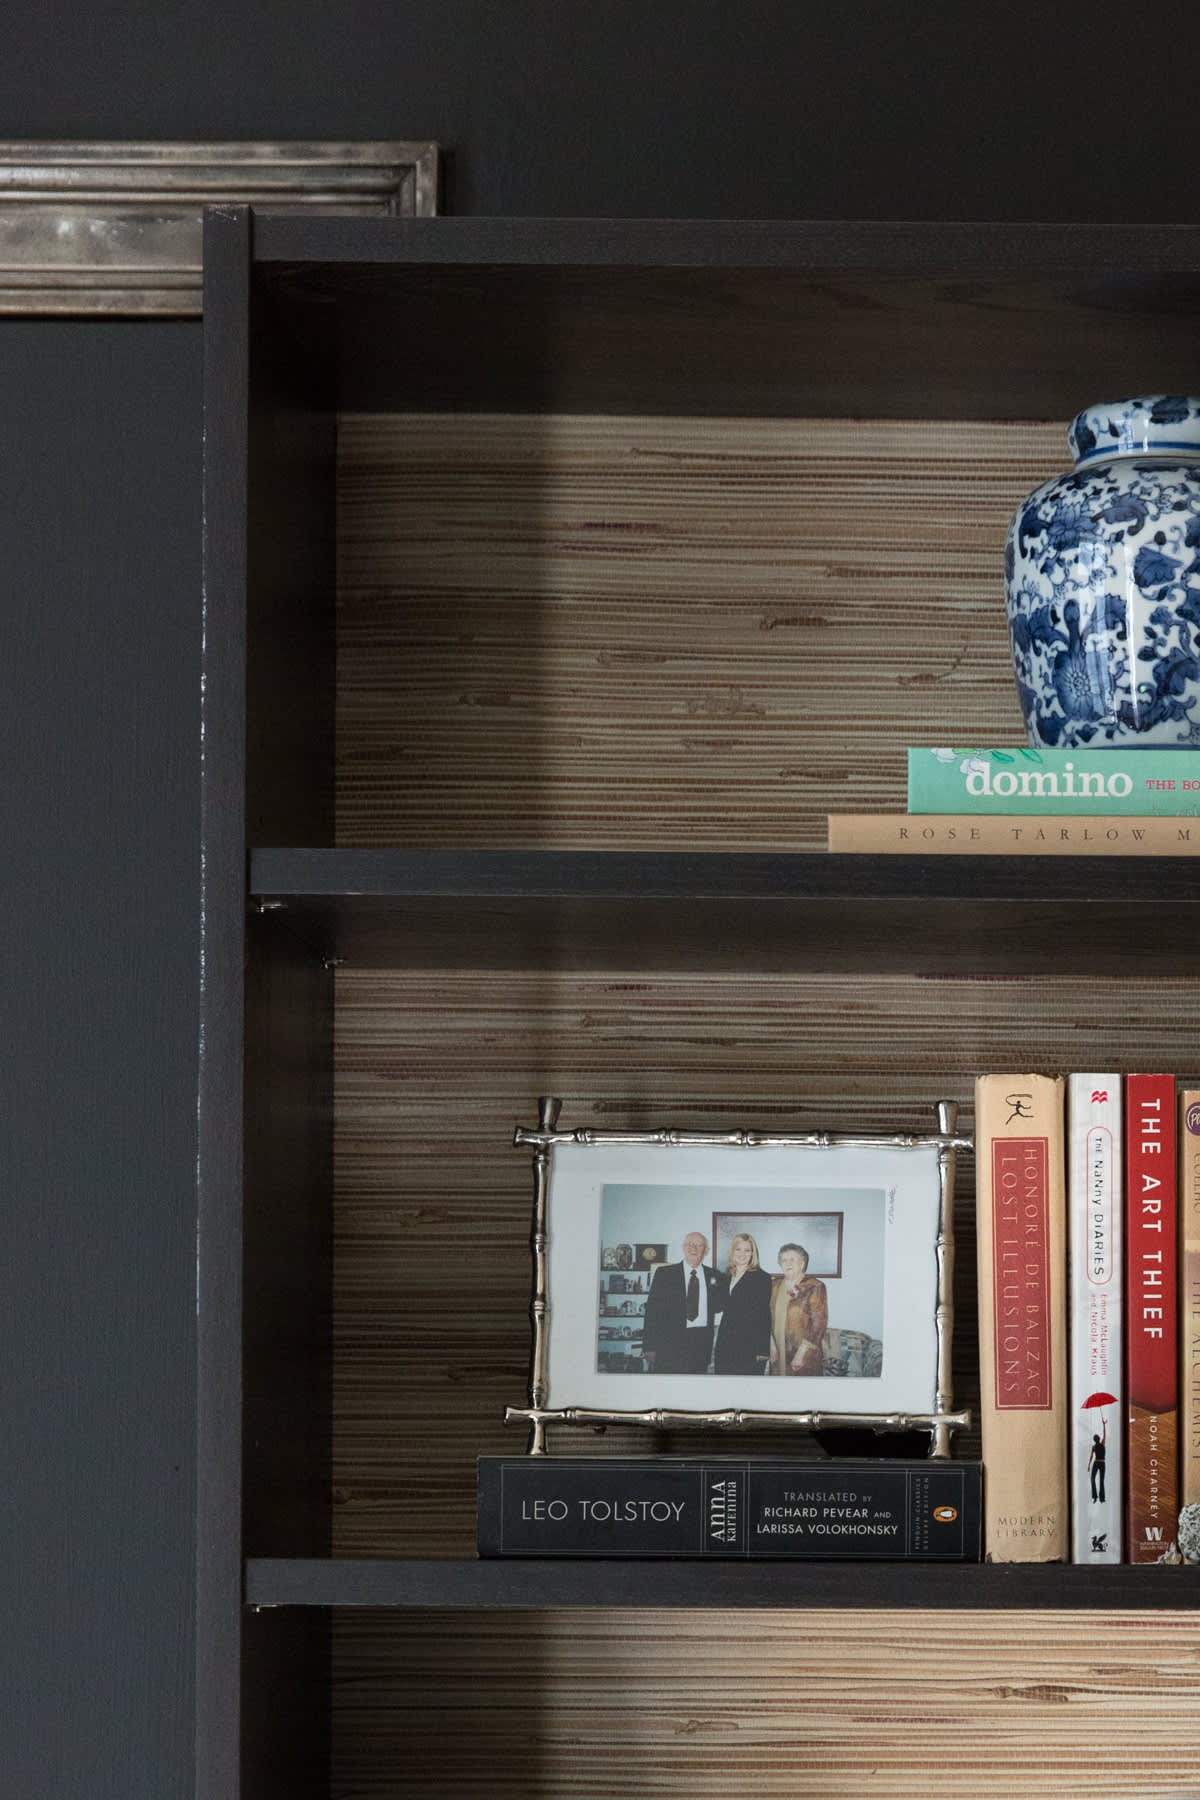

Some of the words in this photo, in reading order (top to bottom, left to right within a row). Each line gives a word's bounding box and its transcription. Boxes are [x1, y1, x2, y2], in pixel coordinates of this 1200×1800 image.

[965, 762, 1134, 797] domino
[1146, 780, 1176, 790] THE
[899, 826, 981, 840] ROSE
[1011, 828, 1146, 841] TARLOW
[1142, 1098, 1161, 1154] THE
[1001, 1157, 1018, 1224] LOST
[1024, 1149, 1041, 1249] HONORÉ
[1142, 1174, 1161, 1233] ART
[1025, 1264, 1039, 1289] DE
[1143, 1250, 1163, 1339] THIEF
[1002, 1240, 1019, 1393] ILLUSIONS
[1025, 1304, 1040, 1398] BALZAC
[1150, 1415, 1158, 1451] NOAH
[1150, 1459, 1159, 1519] CHARNEY
[521, 1500, 569, 1520] LEO
[578, 1500, 686, 1521] TOLSTOY
[764, 1507, 818, 1518] RICHARD
[823, 1508, 869, 1519] PEVEAR
[998, 1516, 1056, 1525] MODERN
[756, 1523, 804, 1534] LARISSA
[808, 1524, 898, 1535] VOLOKHONSKY
[997, 1527, 1056, 1537] LIBRARY
